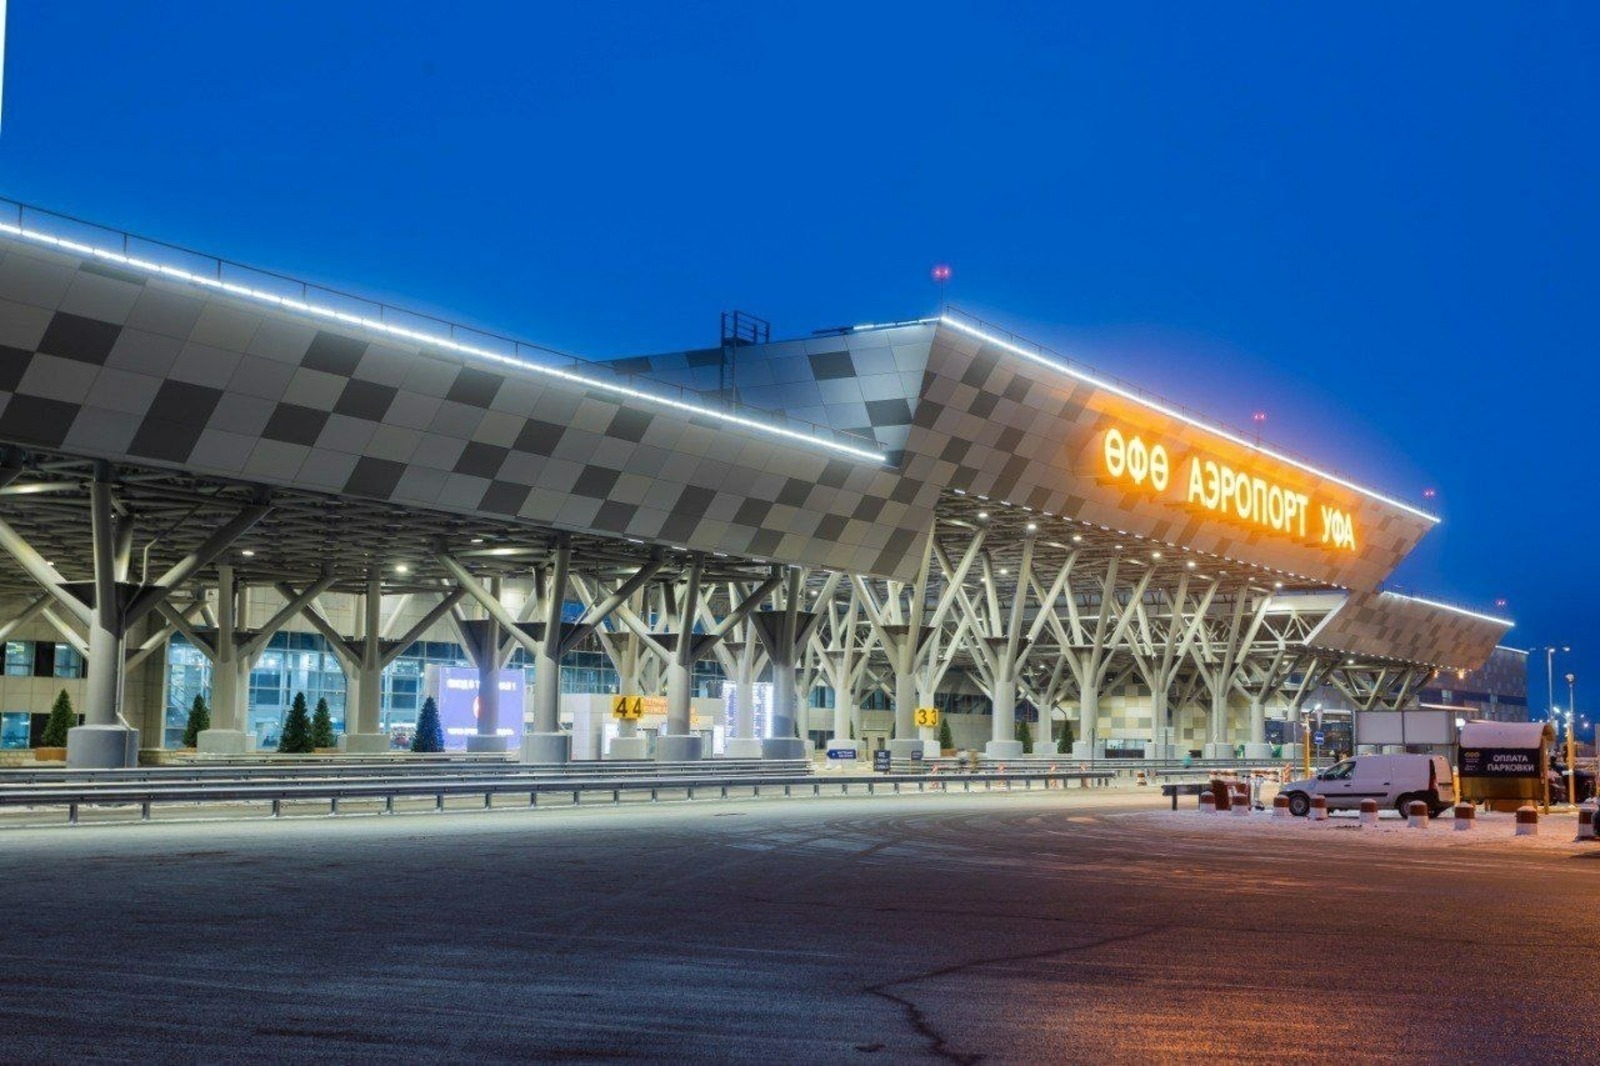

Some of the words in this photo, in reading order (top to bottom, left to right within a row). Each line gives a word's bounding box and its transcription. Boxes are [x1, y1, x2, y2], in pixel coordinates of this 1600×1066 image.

[1188, 456, 1308, 537] АЭРОПОРТ
[1320, 504, 1356, 551] УФА
[1493, 754, 1529, 762] ОПЛАТА
[1487, 763, 1535, 772] ПАРКОВКИ
